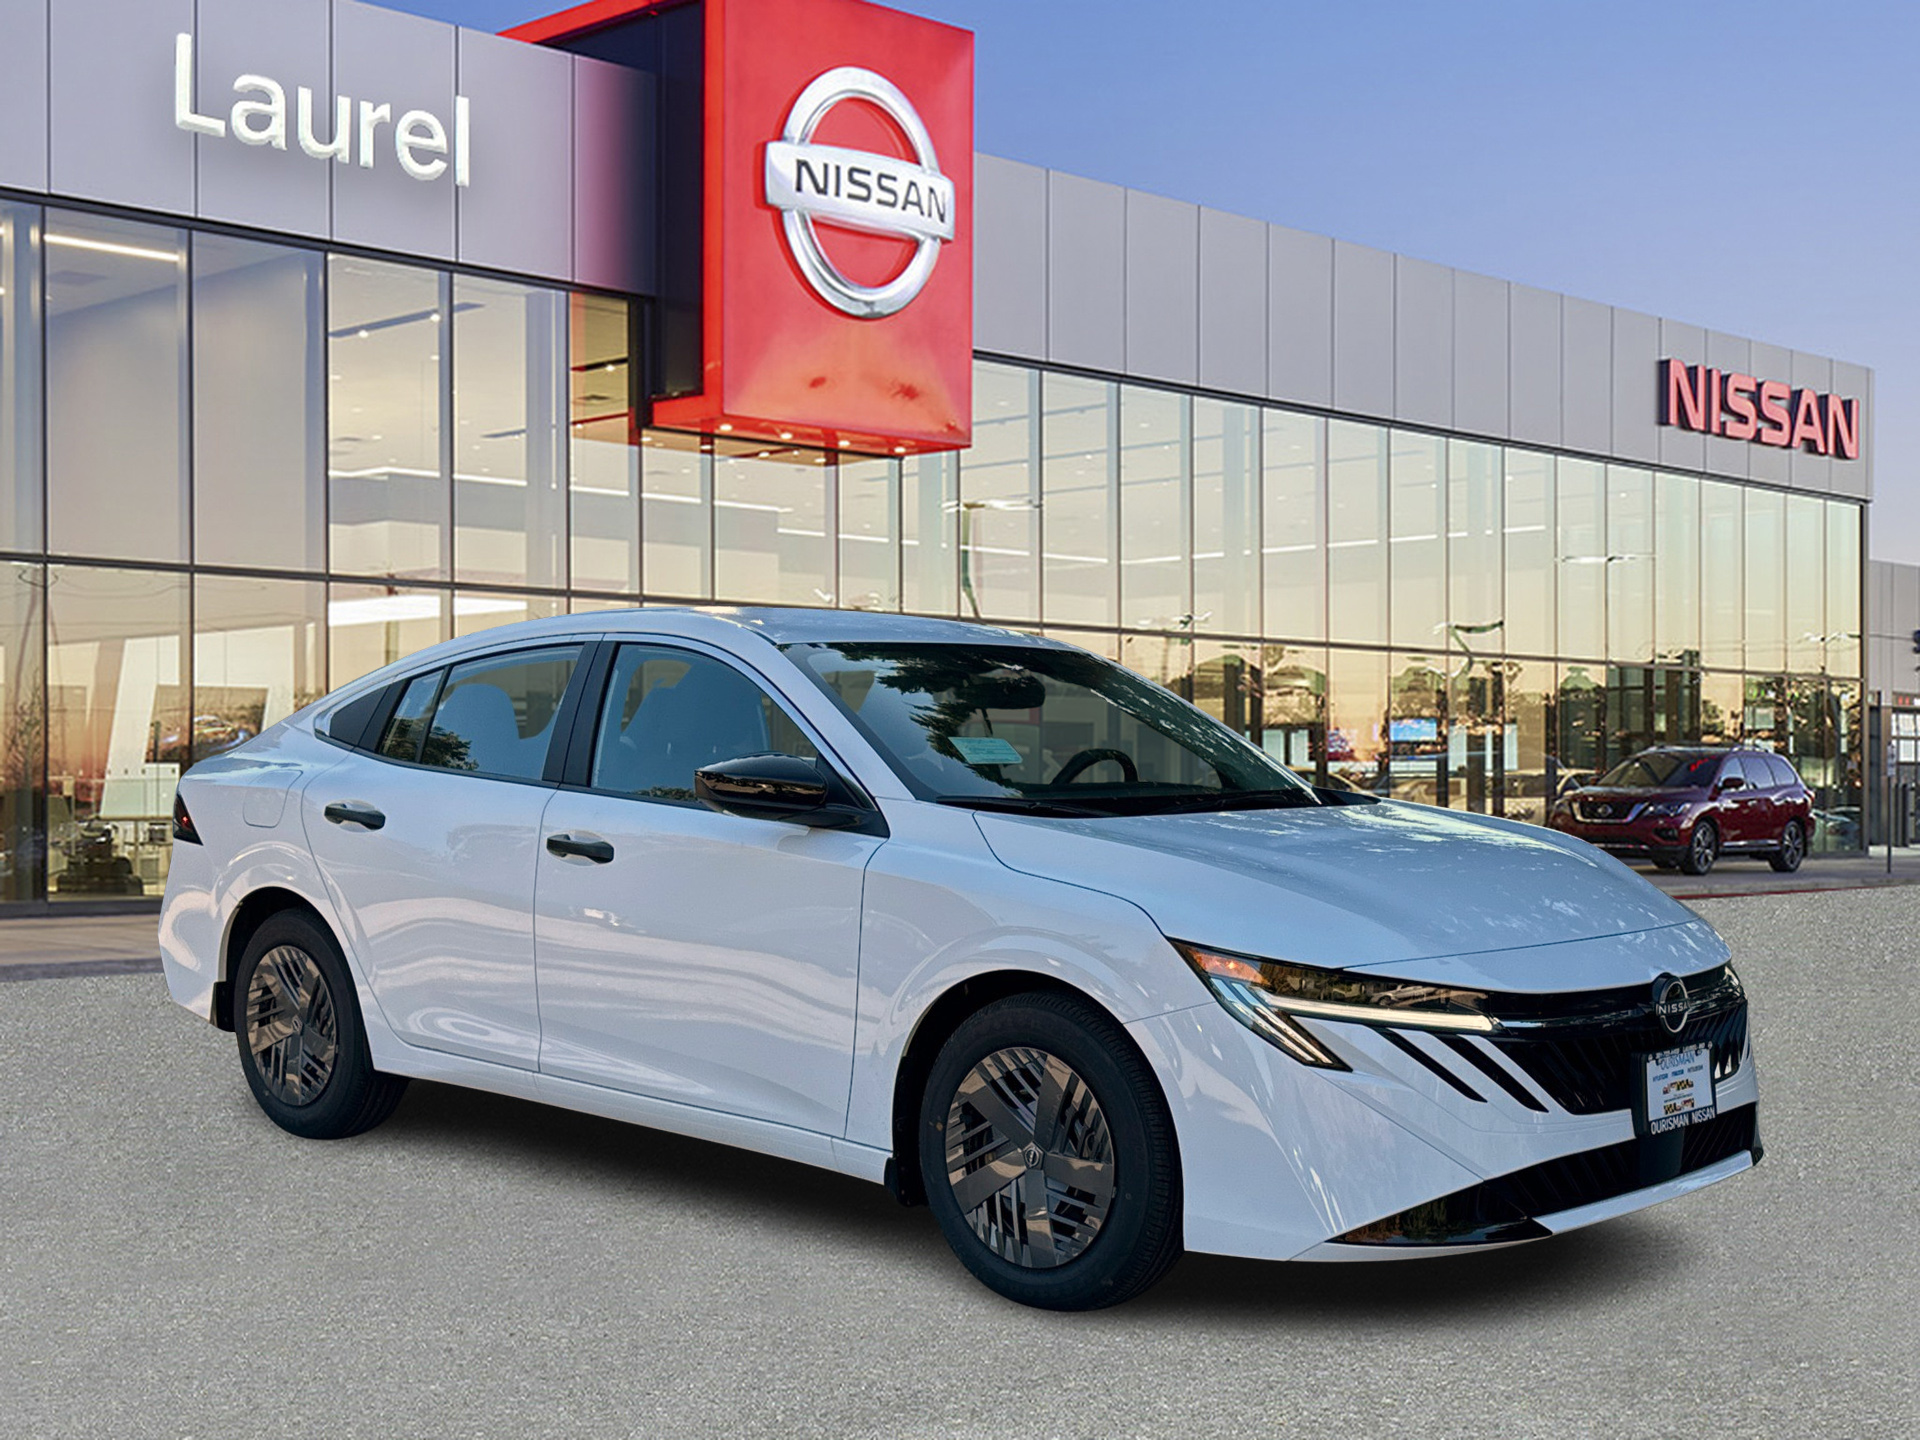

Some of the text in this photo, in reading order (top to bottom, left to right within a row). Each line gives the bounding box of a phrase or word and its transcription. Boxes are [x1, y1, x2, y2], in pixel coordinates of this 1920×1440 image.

[175, 32, 470, 188] Laurel
[795, 158, 946, 223] NISSAN
[1663, 358, 1860, 460] NISSAN
[1650, 1106, 1716, 1135] OURISMAN NISSAN
